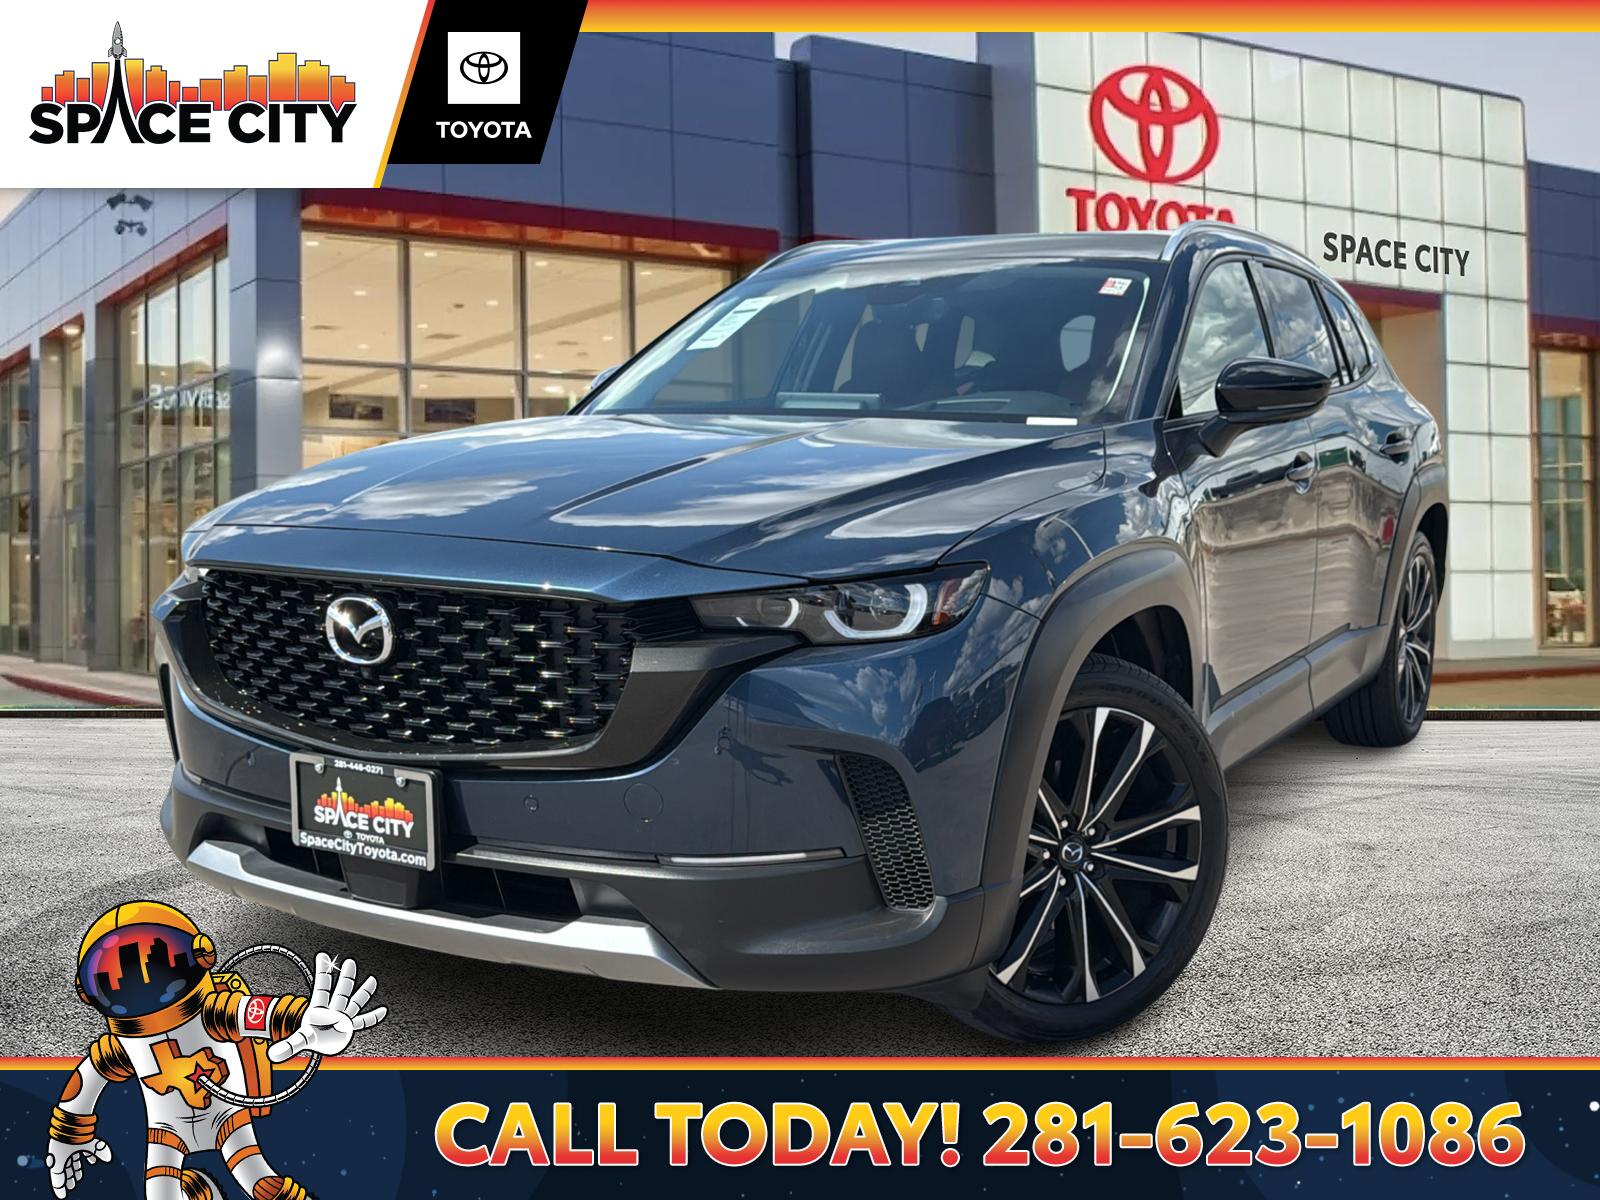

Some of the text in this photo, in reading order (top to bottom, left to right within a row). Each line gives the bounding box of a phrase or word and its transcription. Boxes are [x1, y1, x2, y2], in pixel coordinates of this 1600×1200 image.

[1323, 231, 1470, 277] SPACE CITY
[334, 759, 384, 775] 281-446-0271
[313, 803, 415, 839] SPACE CITY
[355, 832, 385, 846] TOYOTA
[299, 831, 427, 867] SpaceCityToyota.com
